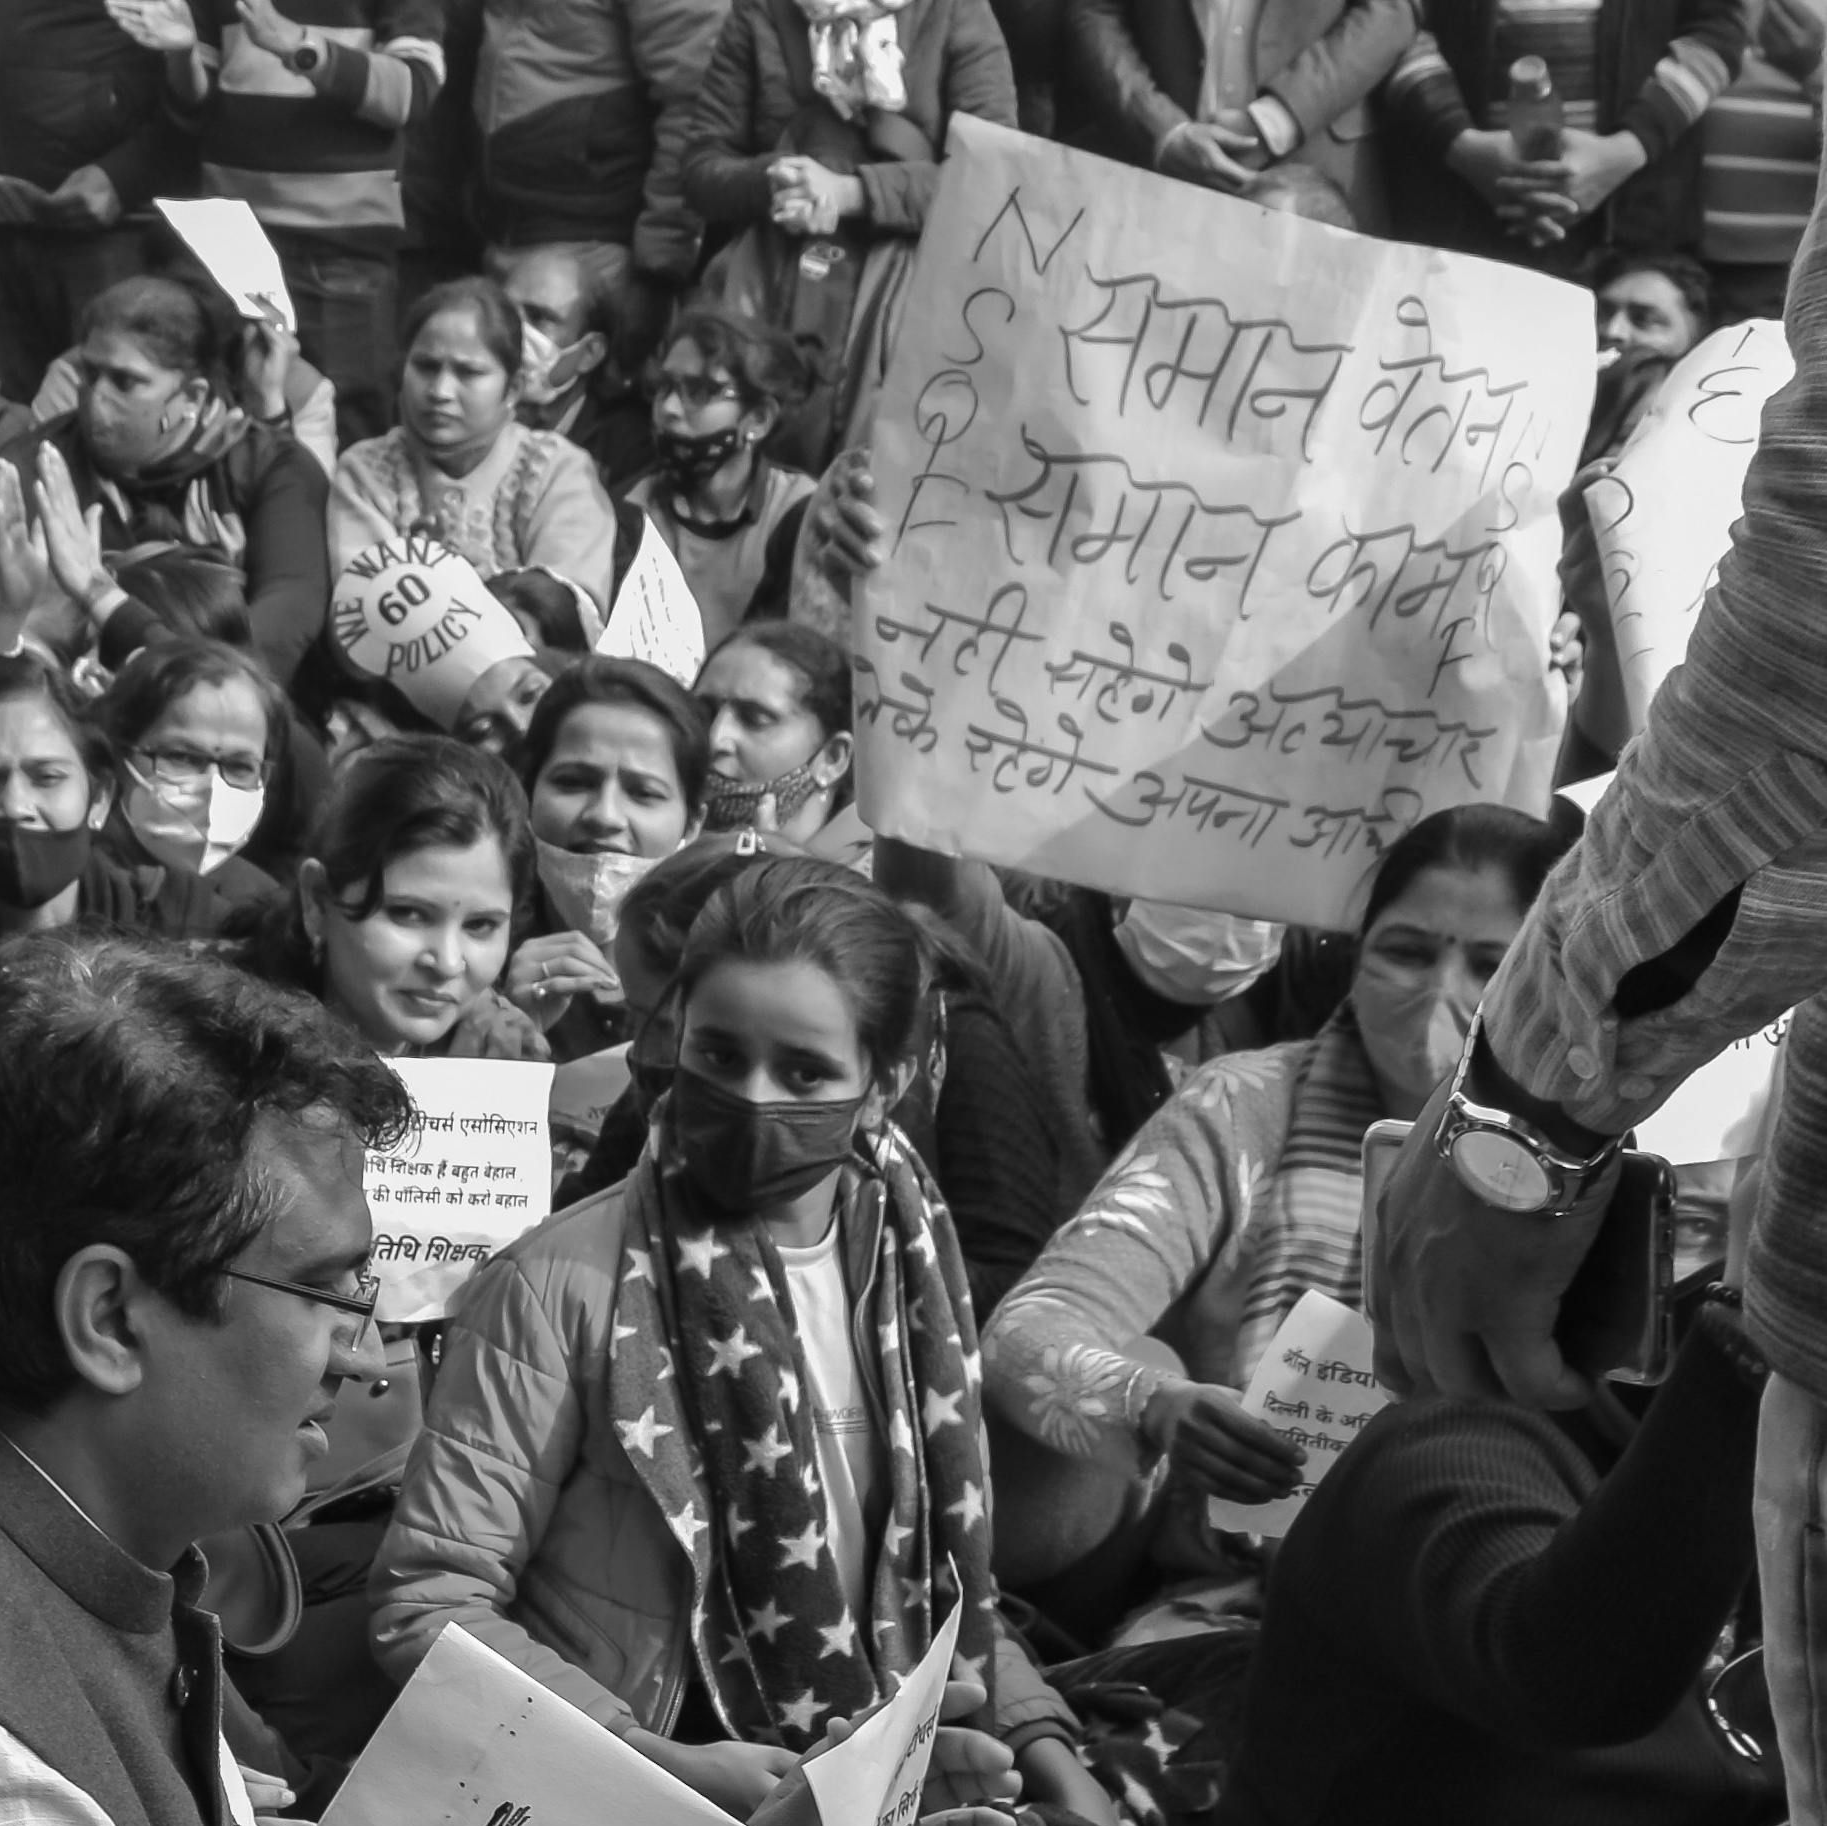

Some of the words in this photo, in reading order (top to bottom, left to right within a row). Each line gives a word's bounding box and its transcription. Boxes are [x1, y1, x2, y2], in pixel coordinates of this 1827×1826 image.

[1058, 262, 1355, 463] समान
[343, 535, 460, 580] WANT
[984, 422, 1302, 620] समान
[1306, 512, 1500, 638] काम
[334, 596, 370, 650] WE
[377, 572, 431, 626] 60
[385, 597, 482, 677] POLICY
[1084, 770, 1291, 848] अपना
[372, 1234, 421, 1262] तिथि
[425, 1236, 491, 1262] शिक्षक
